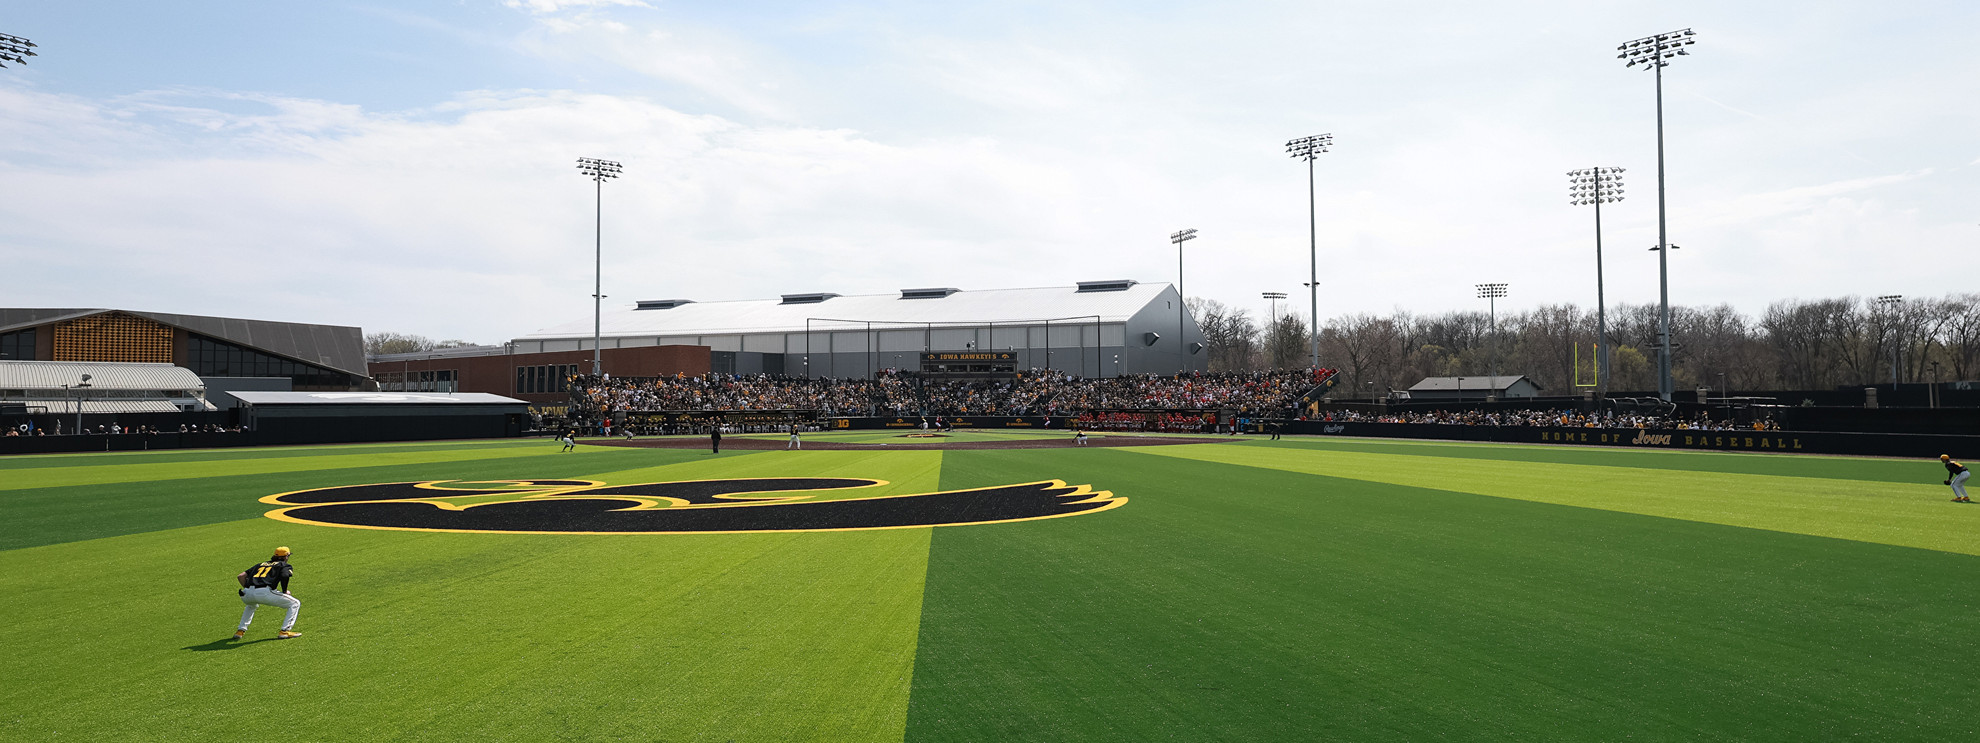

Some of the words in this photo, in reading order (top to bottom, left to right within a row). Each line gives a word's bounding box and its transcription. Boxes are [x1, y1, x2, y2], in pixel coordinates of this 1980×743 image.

[1542, 431, 1588, 442] HOME
[1601, 433, 1620, 443] OF
[1631, 429, 1672, 445] Iowa
[1685, 435, 1802, 449] BASEBALL
[253, 566, 272, 578] 11
